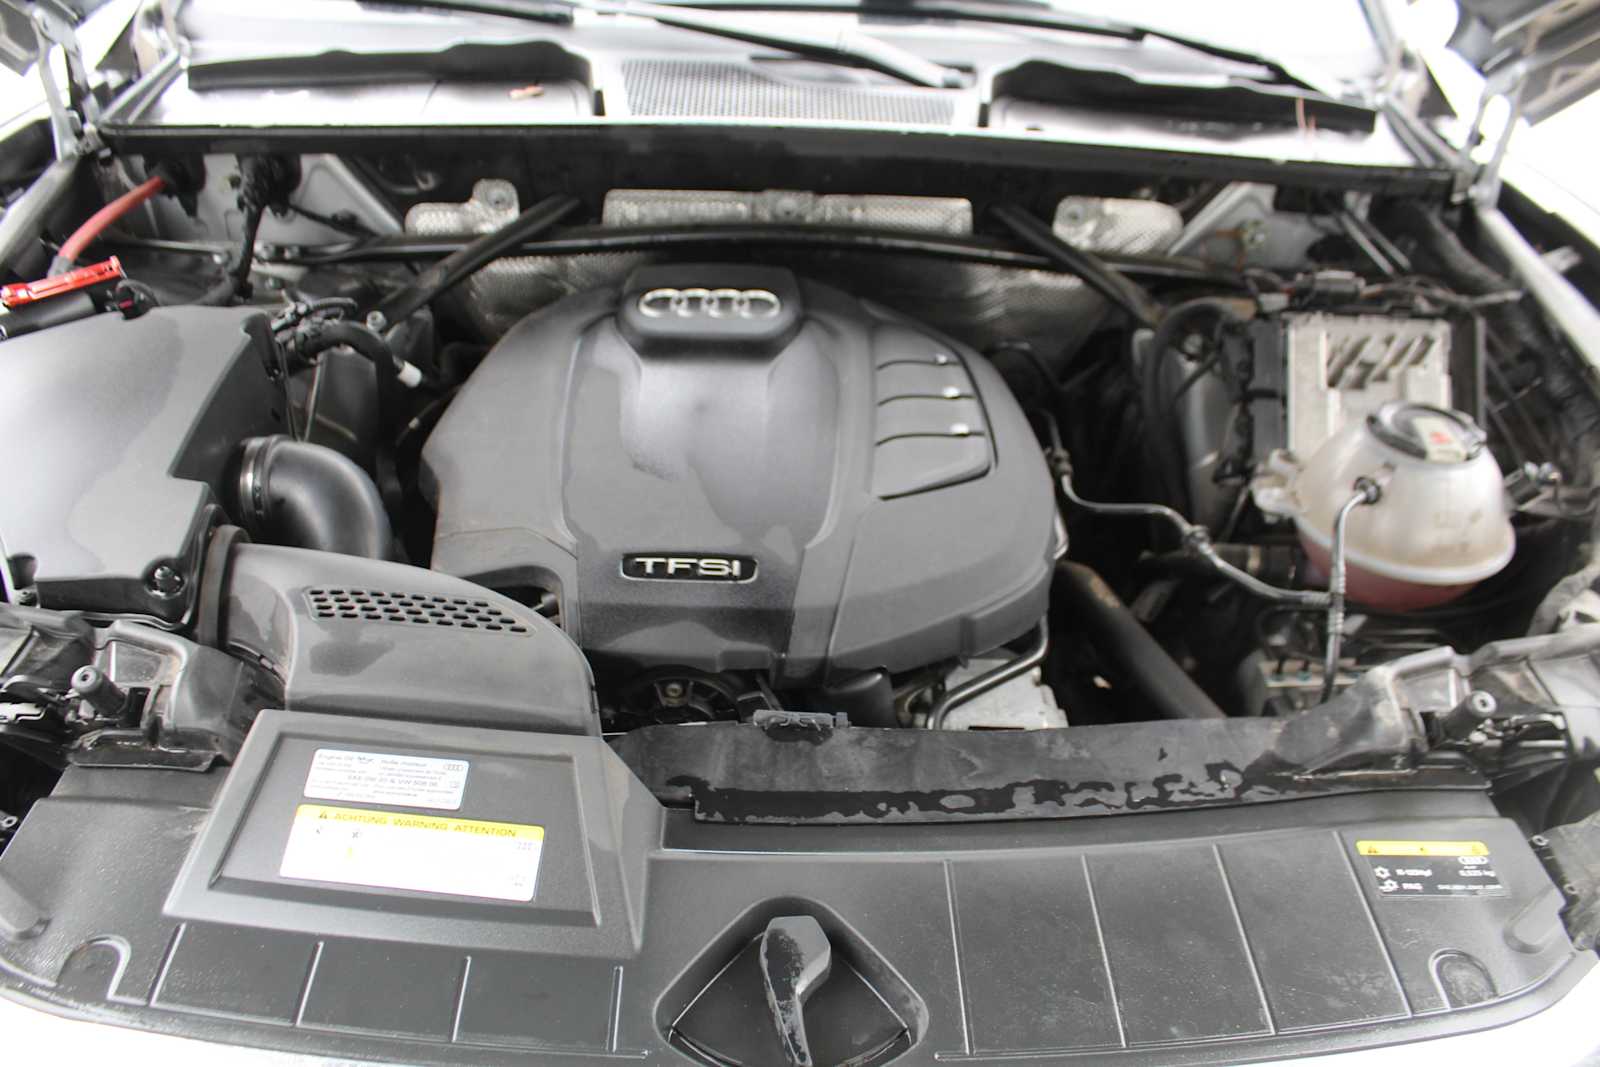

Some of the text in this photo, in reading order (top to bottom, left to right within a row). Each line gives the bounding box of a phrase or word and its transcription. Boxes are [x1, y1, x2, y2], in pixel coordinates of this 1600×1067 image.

[635, 557, 741, 577] TFSI
[333, 813, 517, 838] ACHTUNG WARNING ATTENTION
